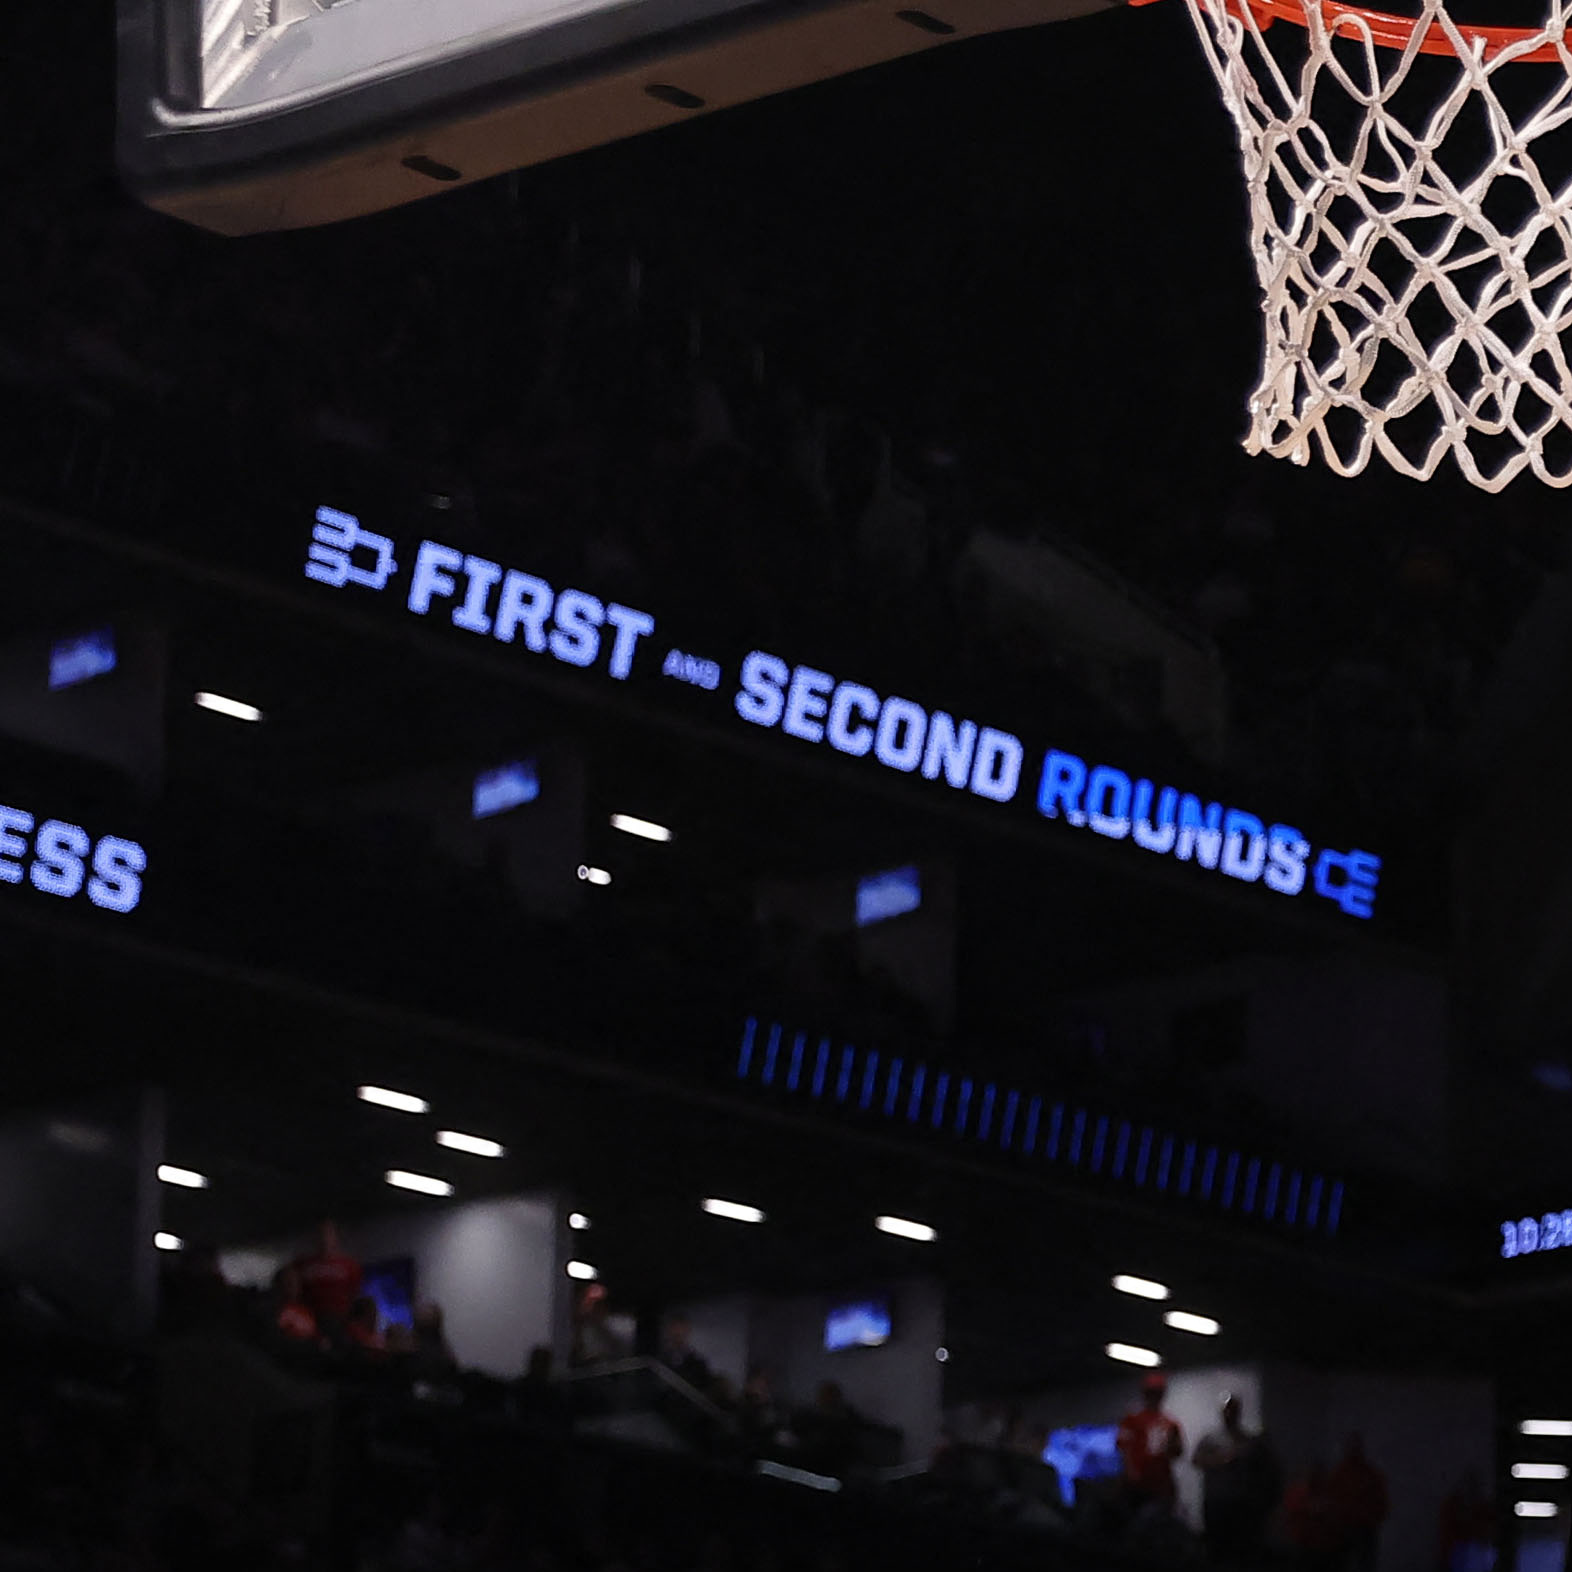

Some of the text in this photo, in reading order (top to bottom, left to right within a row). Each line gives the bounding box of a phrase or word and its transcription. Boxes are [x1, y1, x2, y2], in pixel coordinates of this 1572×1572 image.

[407, 539, 655, 681] FIRST
[734, 650, 1024, 803] SECOND
[1037, 748, 1311, 897] ROUNDS
[0, 803, 148, 914] ESS
